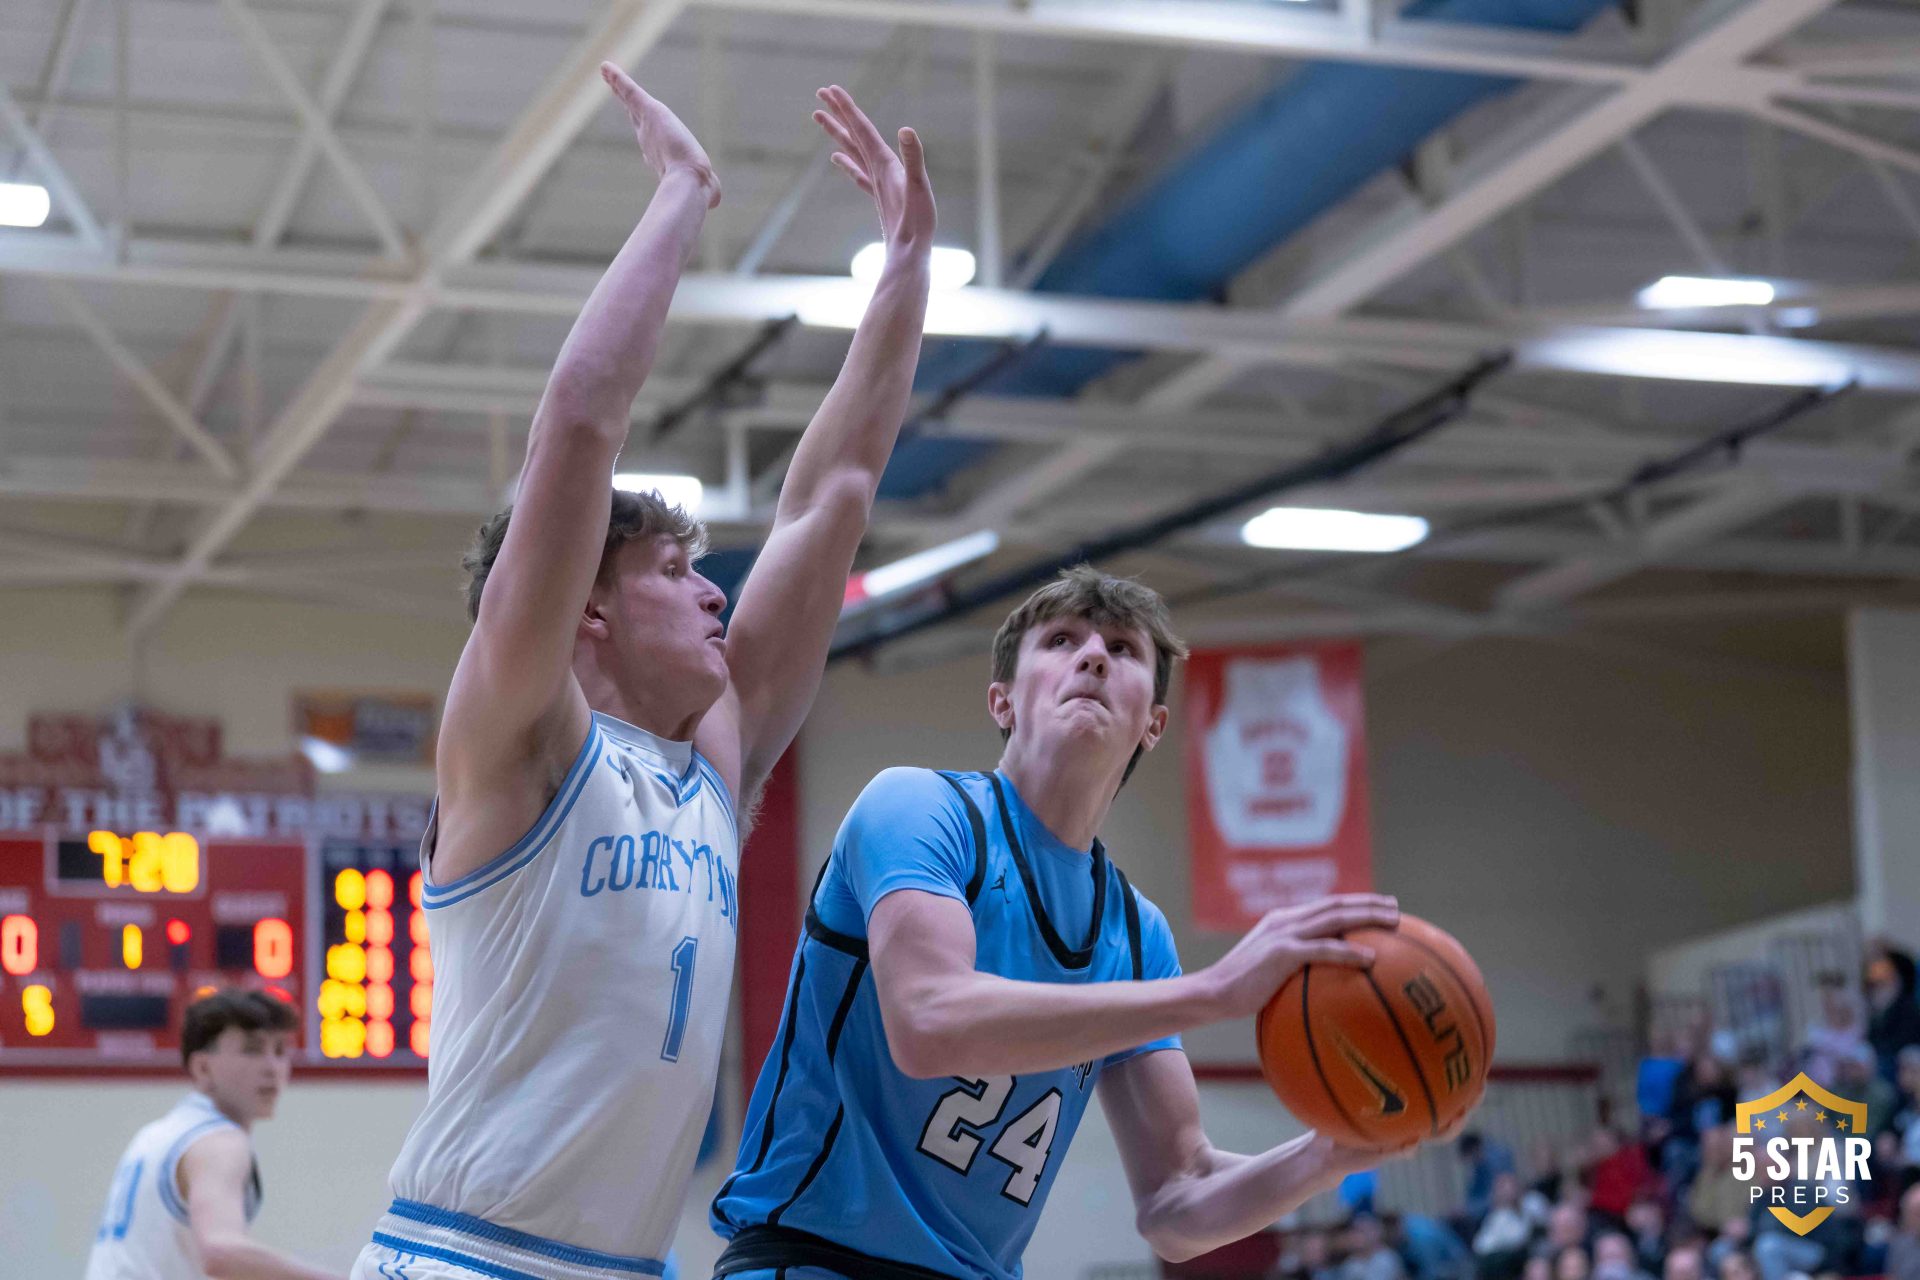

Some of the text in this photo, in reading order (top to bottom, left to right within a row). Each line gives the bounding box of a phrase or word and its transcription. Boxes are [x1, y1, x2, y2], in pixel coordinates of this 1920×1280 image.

[660, 936, 698, 1063] 1
[1403, 972, 1471, 1095] ELITE
[916, 1074, 1063, 1208] 24
